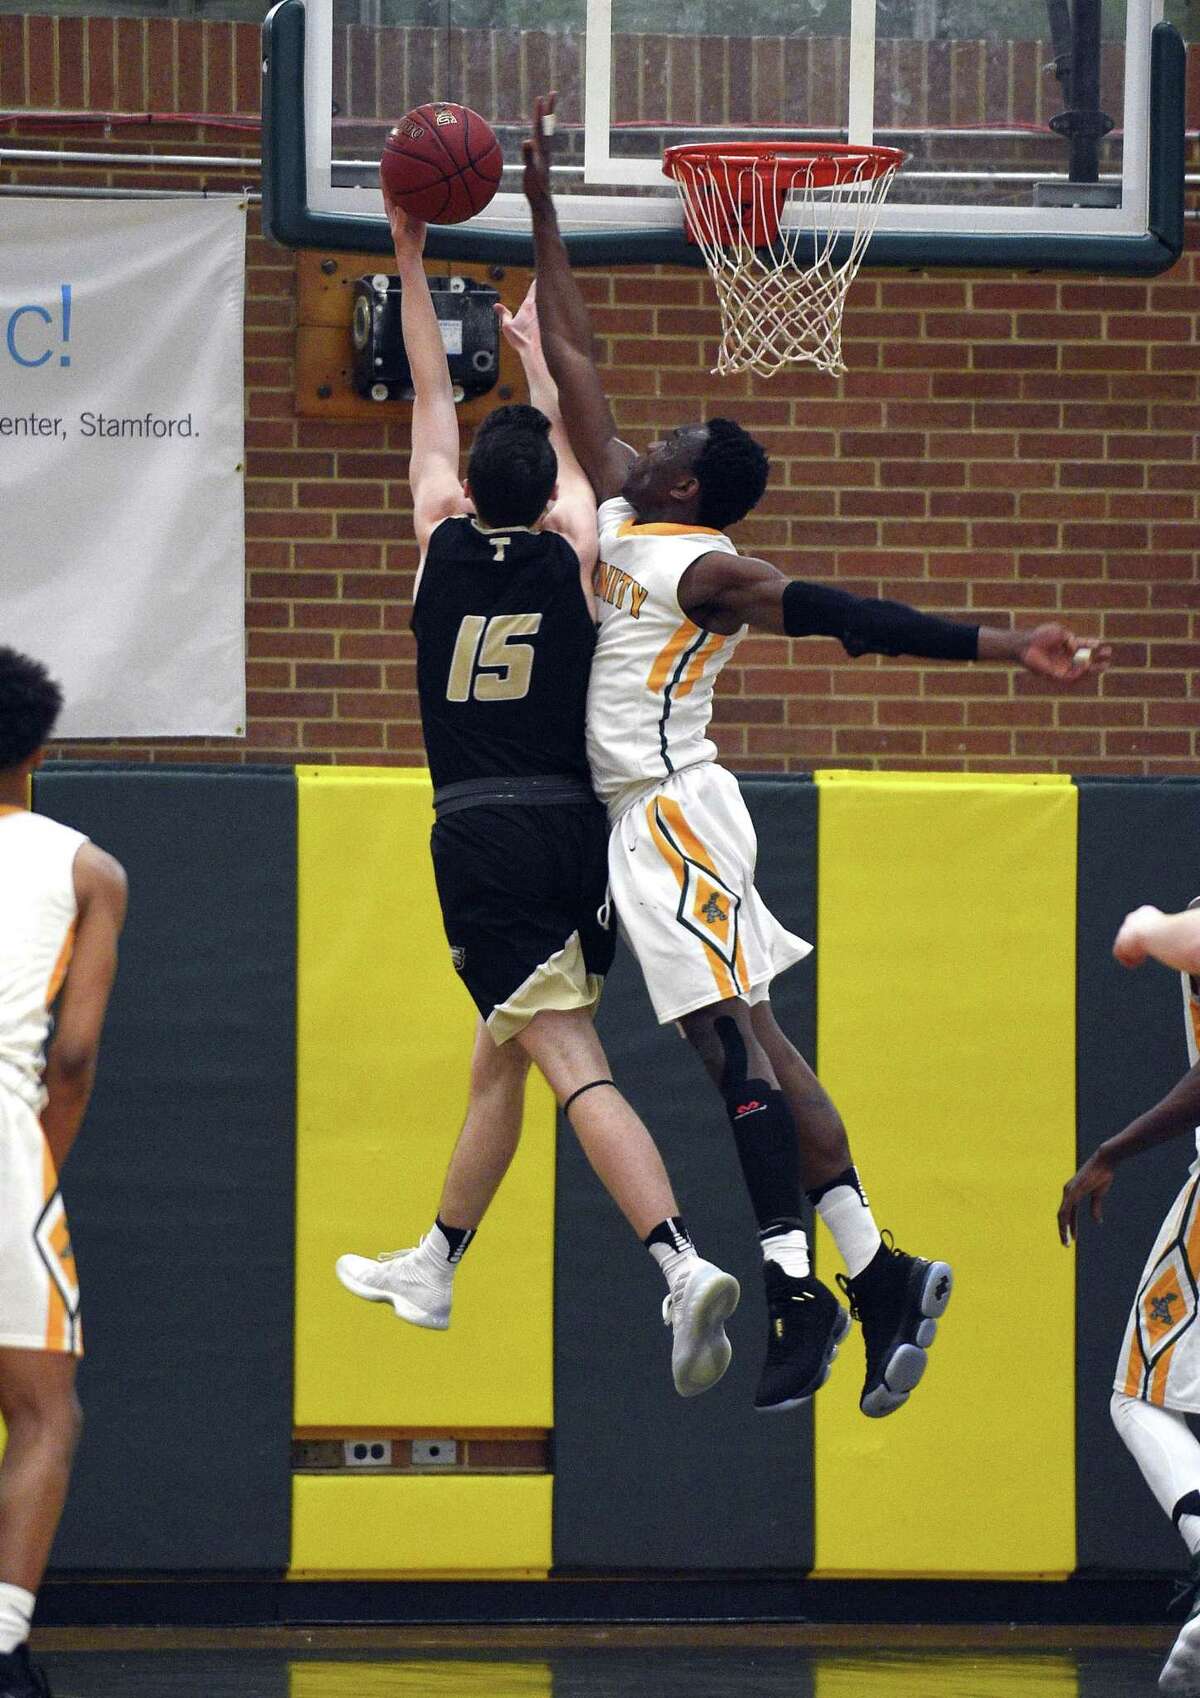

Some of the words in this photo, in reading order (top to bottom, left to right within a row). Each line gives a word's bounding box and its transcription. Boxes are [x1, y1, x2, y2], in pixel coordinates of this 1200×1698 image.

[7, 284, 71, 368] C!
[80, 412, 200, 438] Stamford.
[446, 613, 543, 702] 15
